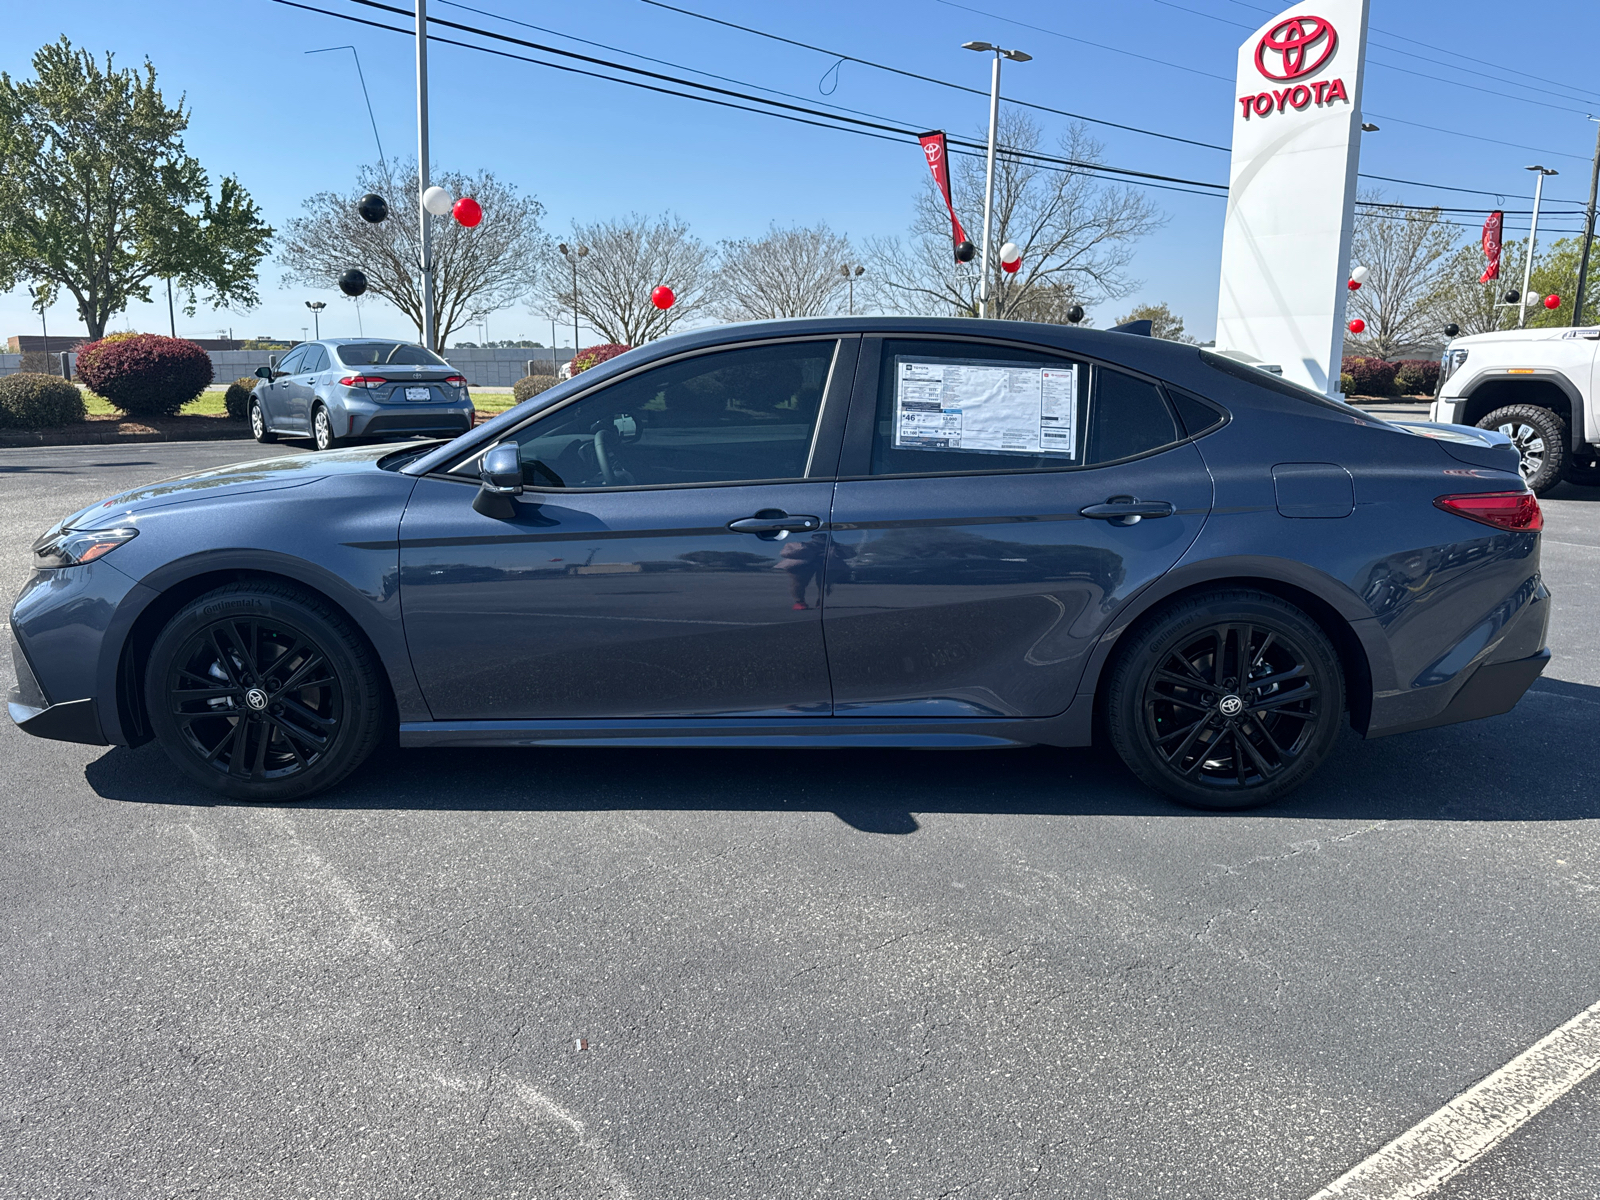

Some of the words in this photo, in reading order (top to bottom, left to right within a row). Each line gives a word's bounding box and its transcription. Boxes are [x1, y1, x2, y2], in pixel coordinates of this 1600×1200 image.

[1239, 78, 1348, 119] TOYOTA
[203, 599, 254, 616] Continental
[1150, 614, 1194, 653] Continental
